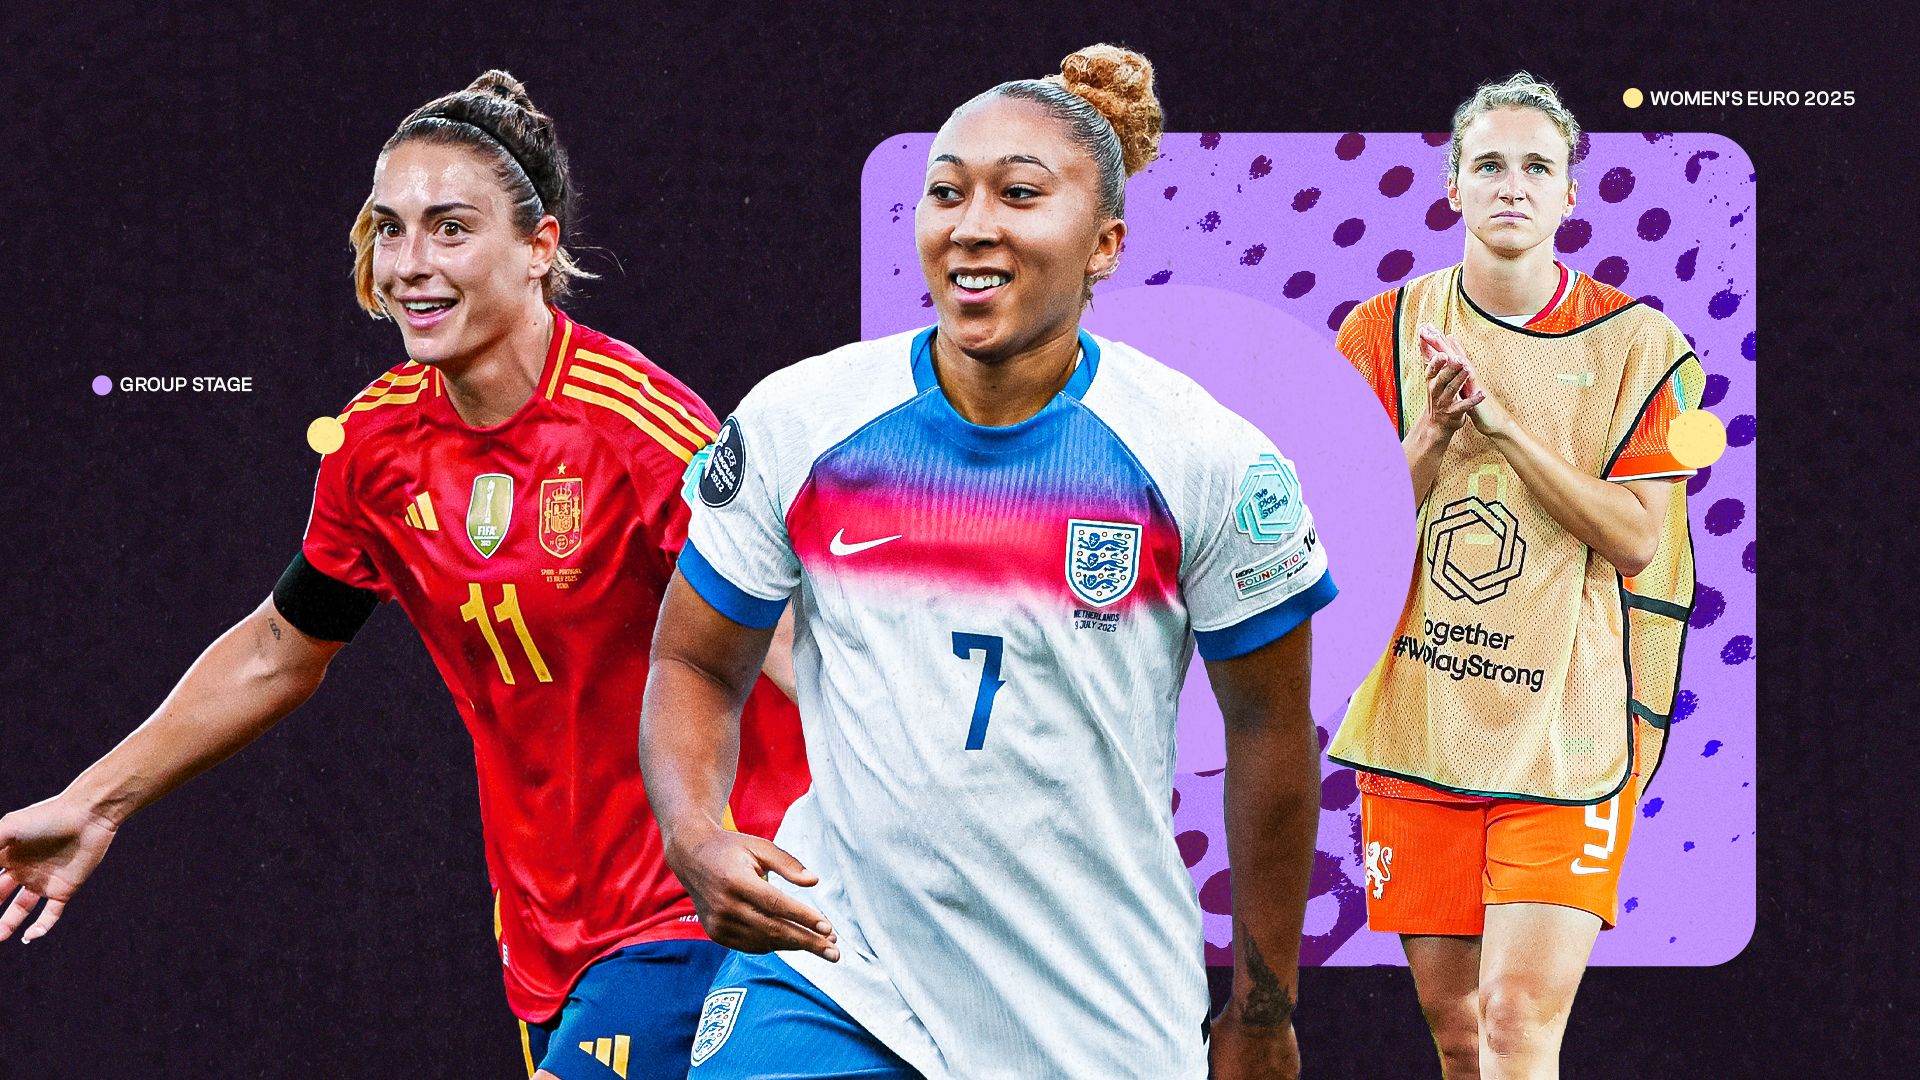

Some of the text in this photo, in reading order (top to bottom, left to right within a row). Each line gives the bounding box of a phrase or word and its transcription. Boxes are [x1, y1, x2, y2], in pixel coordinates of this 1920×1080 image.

[710, 470, 725, 492] 2022
[477, 526, 497, 536] FIFA
[1237, 548, 1305, 589] FOUNDATION
[1074, 609, 1119, 622] NETHERLANDS
[1075, 620, 1117, 632] 9 JULY 2025
[460, 583, 553, 685] 11
[1424, 612, 1514, 650] ogether
[952, 631, 1006, 750] 7
